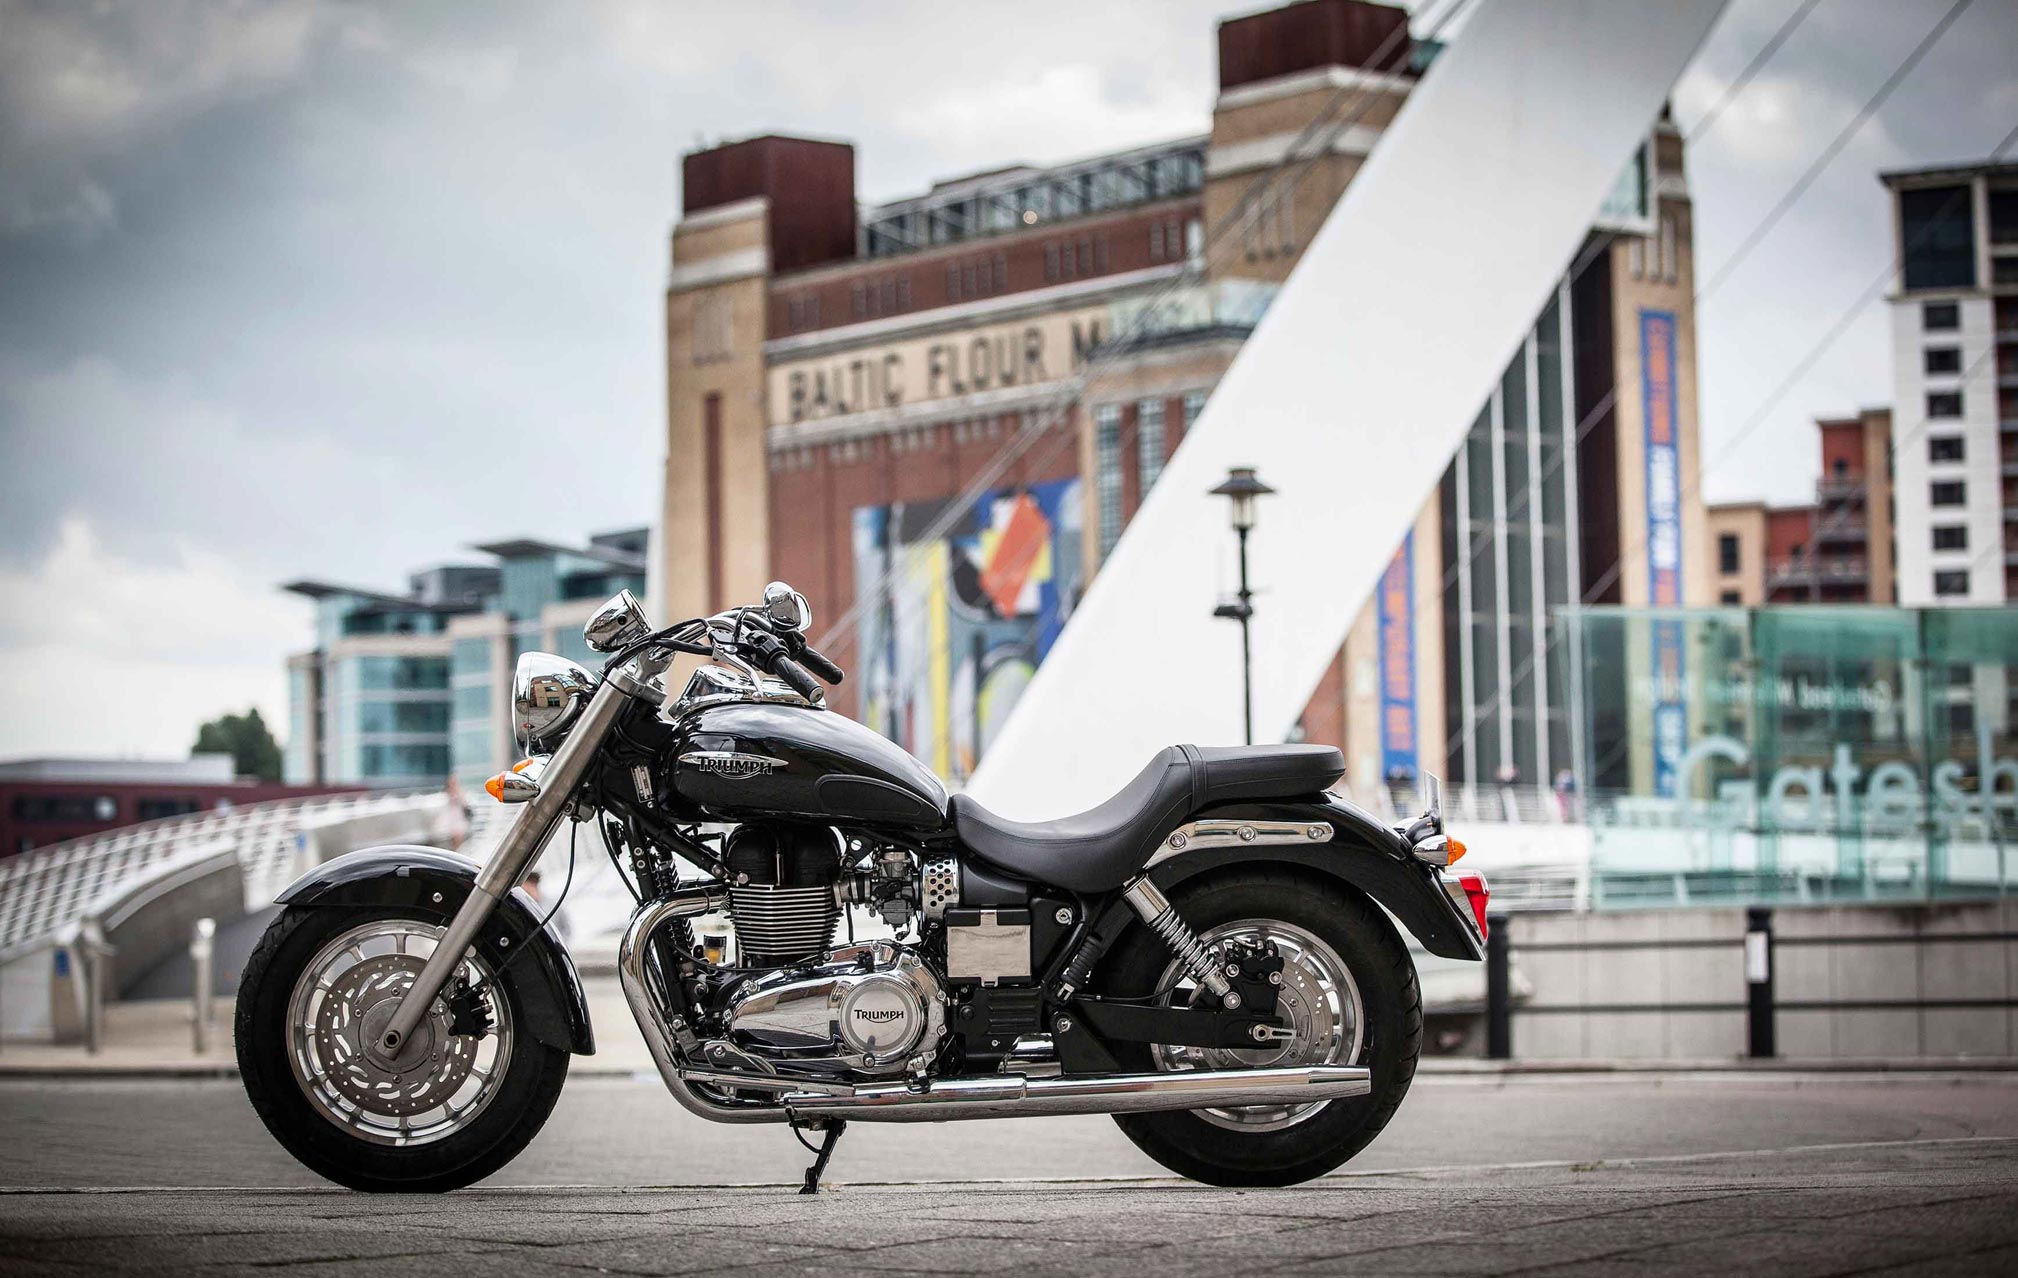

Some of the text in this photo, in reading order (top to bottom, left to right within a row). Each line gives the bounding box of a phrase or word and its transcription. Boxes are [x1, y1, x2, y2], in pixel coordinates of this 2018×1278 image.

[787, 352, 903, 423] BALTIC
[928, 325, 1046, 400] FLOUR
[697, 756, 773, 779] TRIUMPH
[854, 1009, 904, 1023] TRIUMPH
